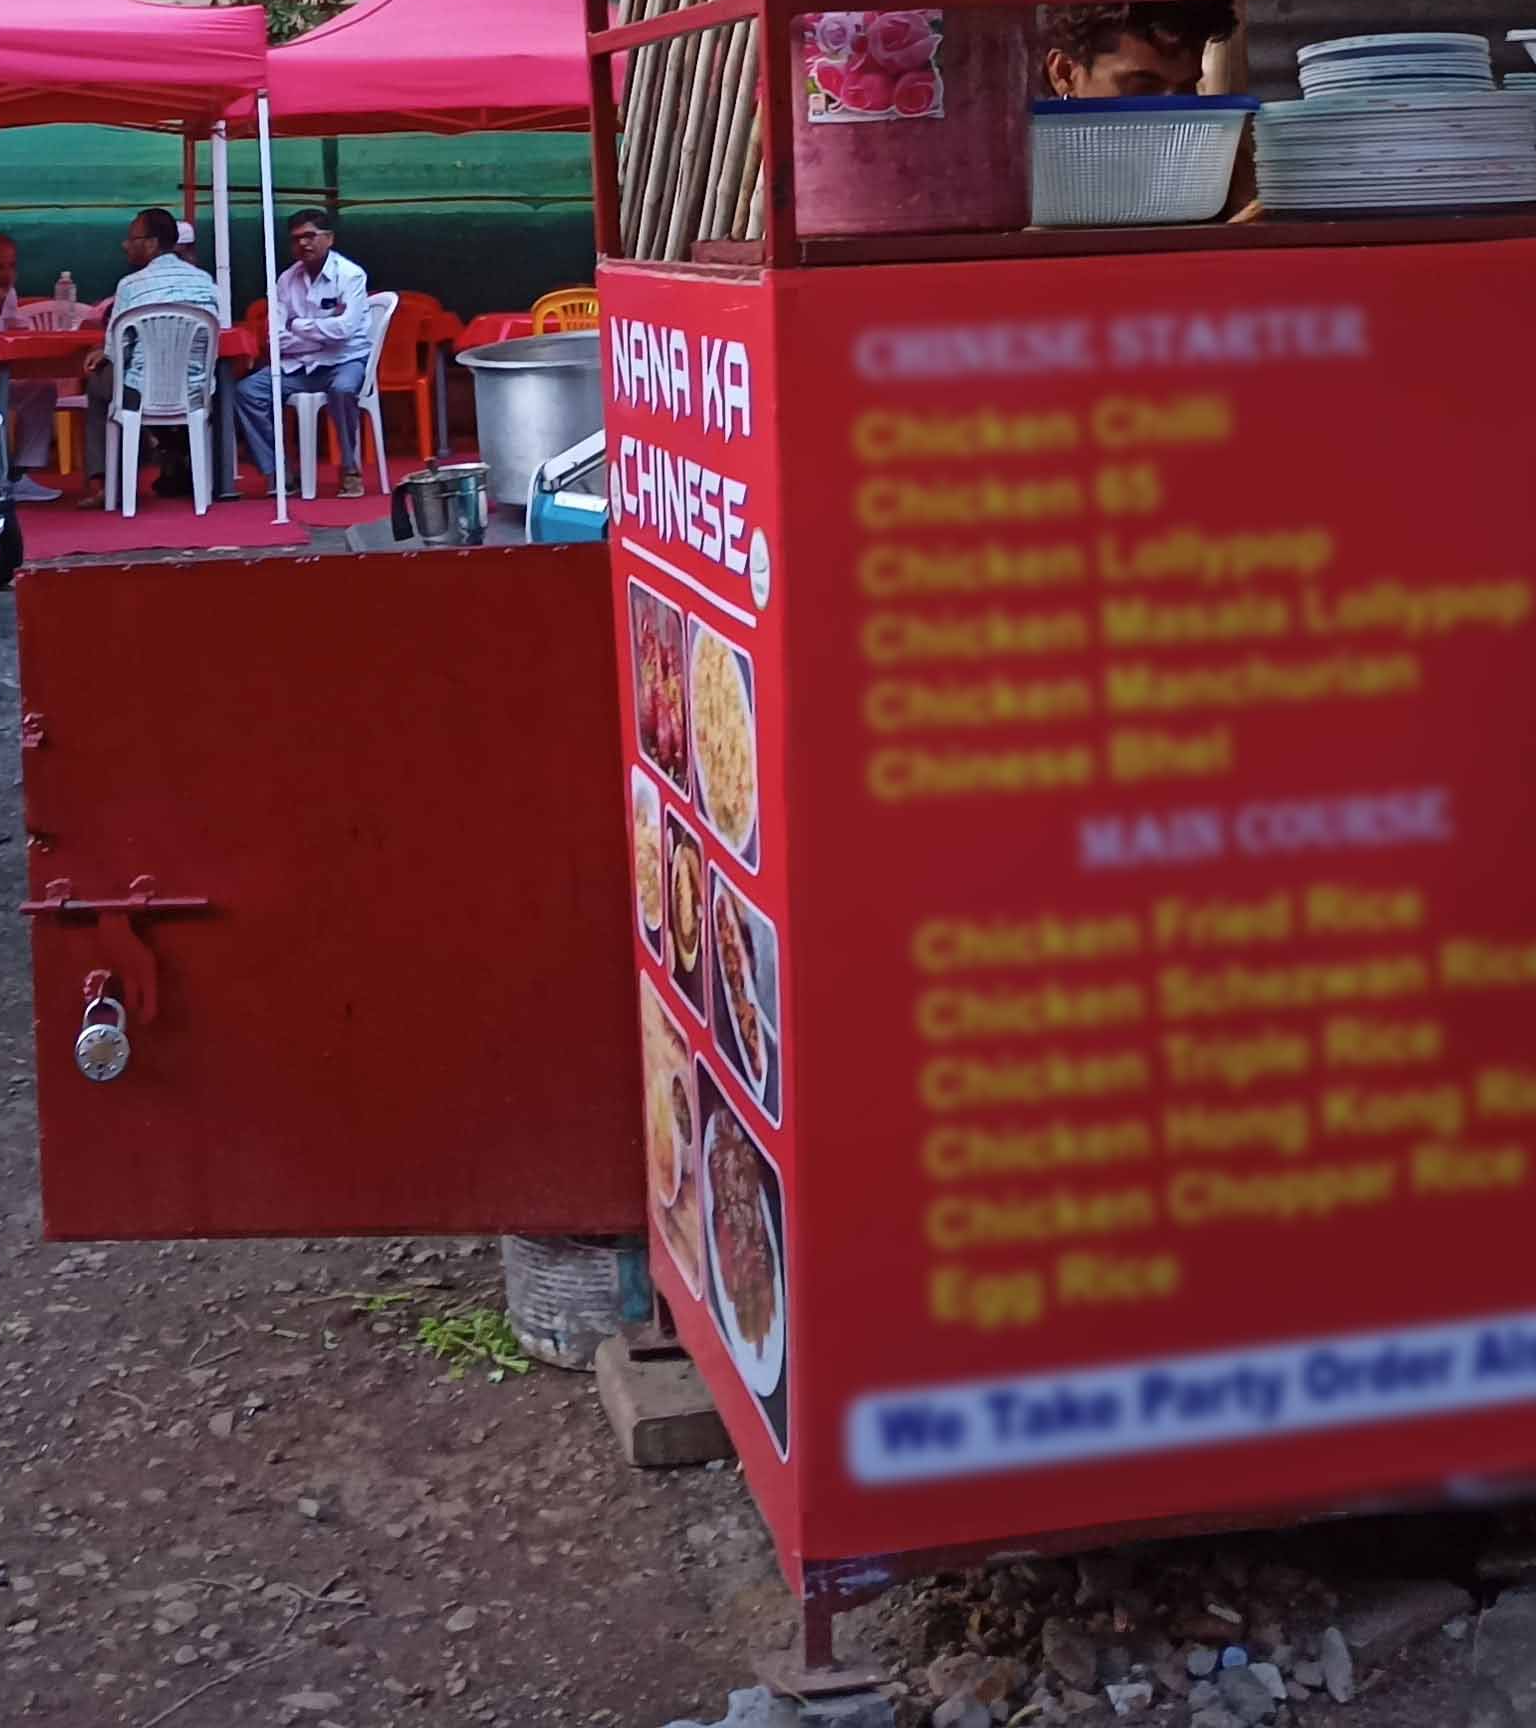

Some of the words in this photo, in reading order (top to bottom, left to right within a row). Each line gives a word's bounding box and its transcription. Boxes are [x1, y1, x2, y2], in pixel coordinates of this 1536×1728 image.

[610, 316, 691, 422] NANA
[701, 335, 752, 443] KA
[620, 435, 749, 576] CHINESE
